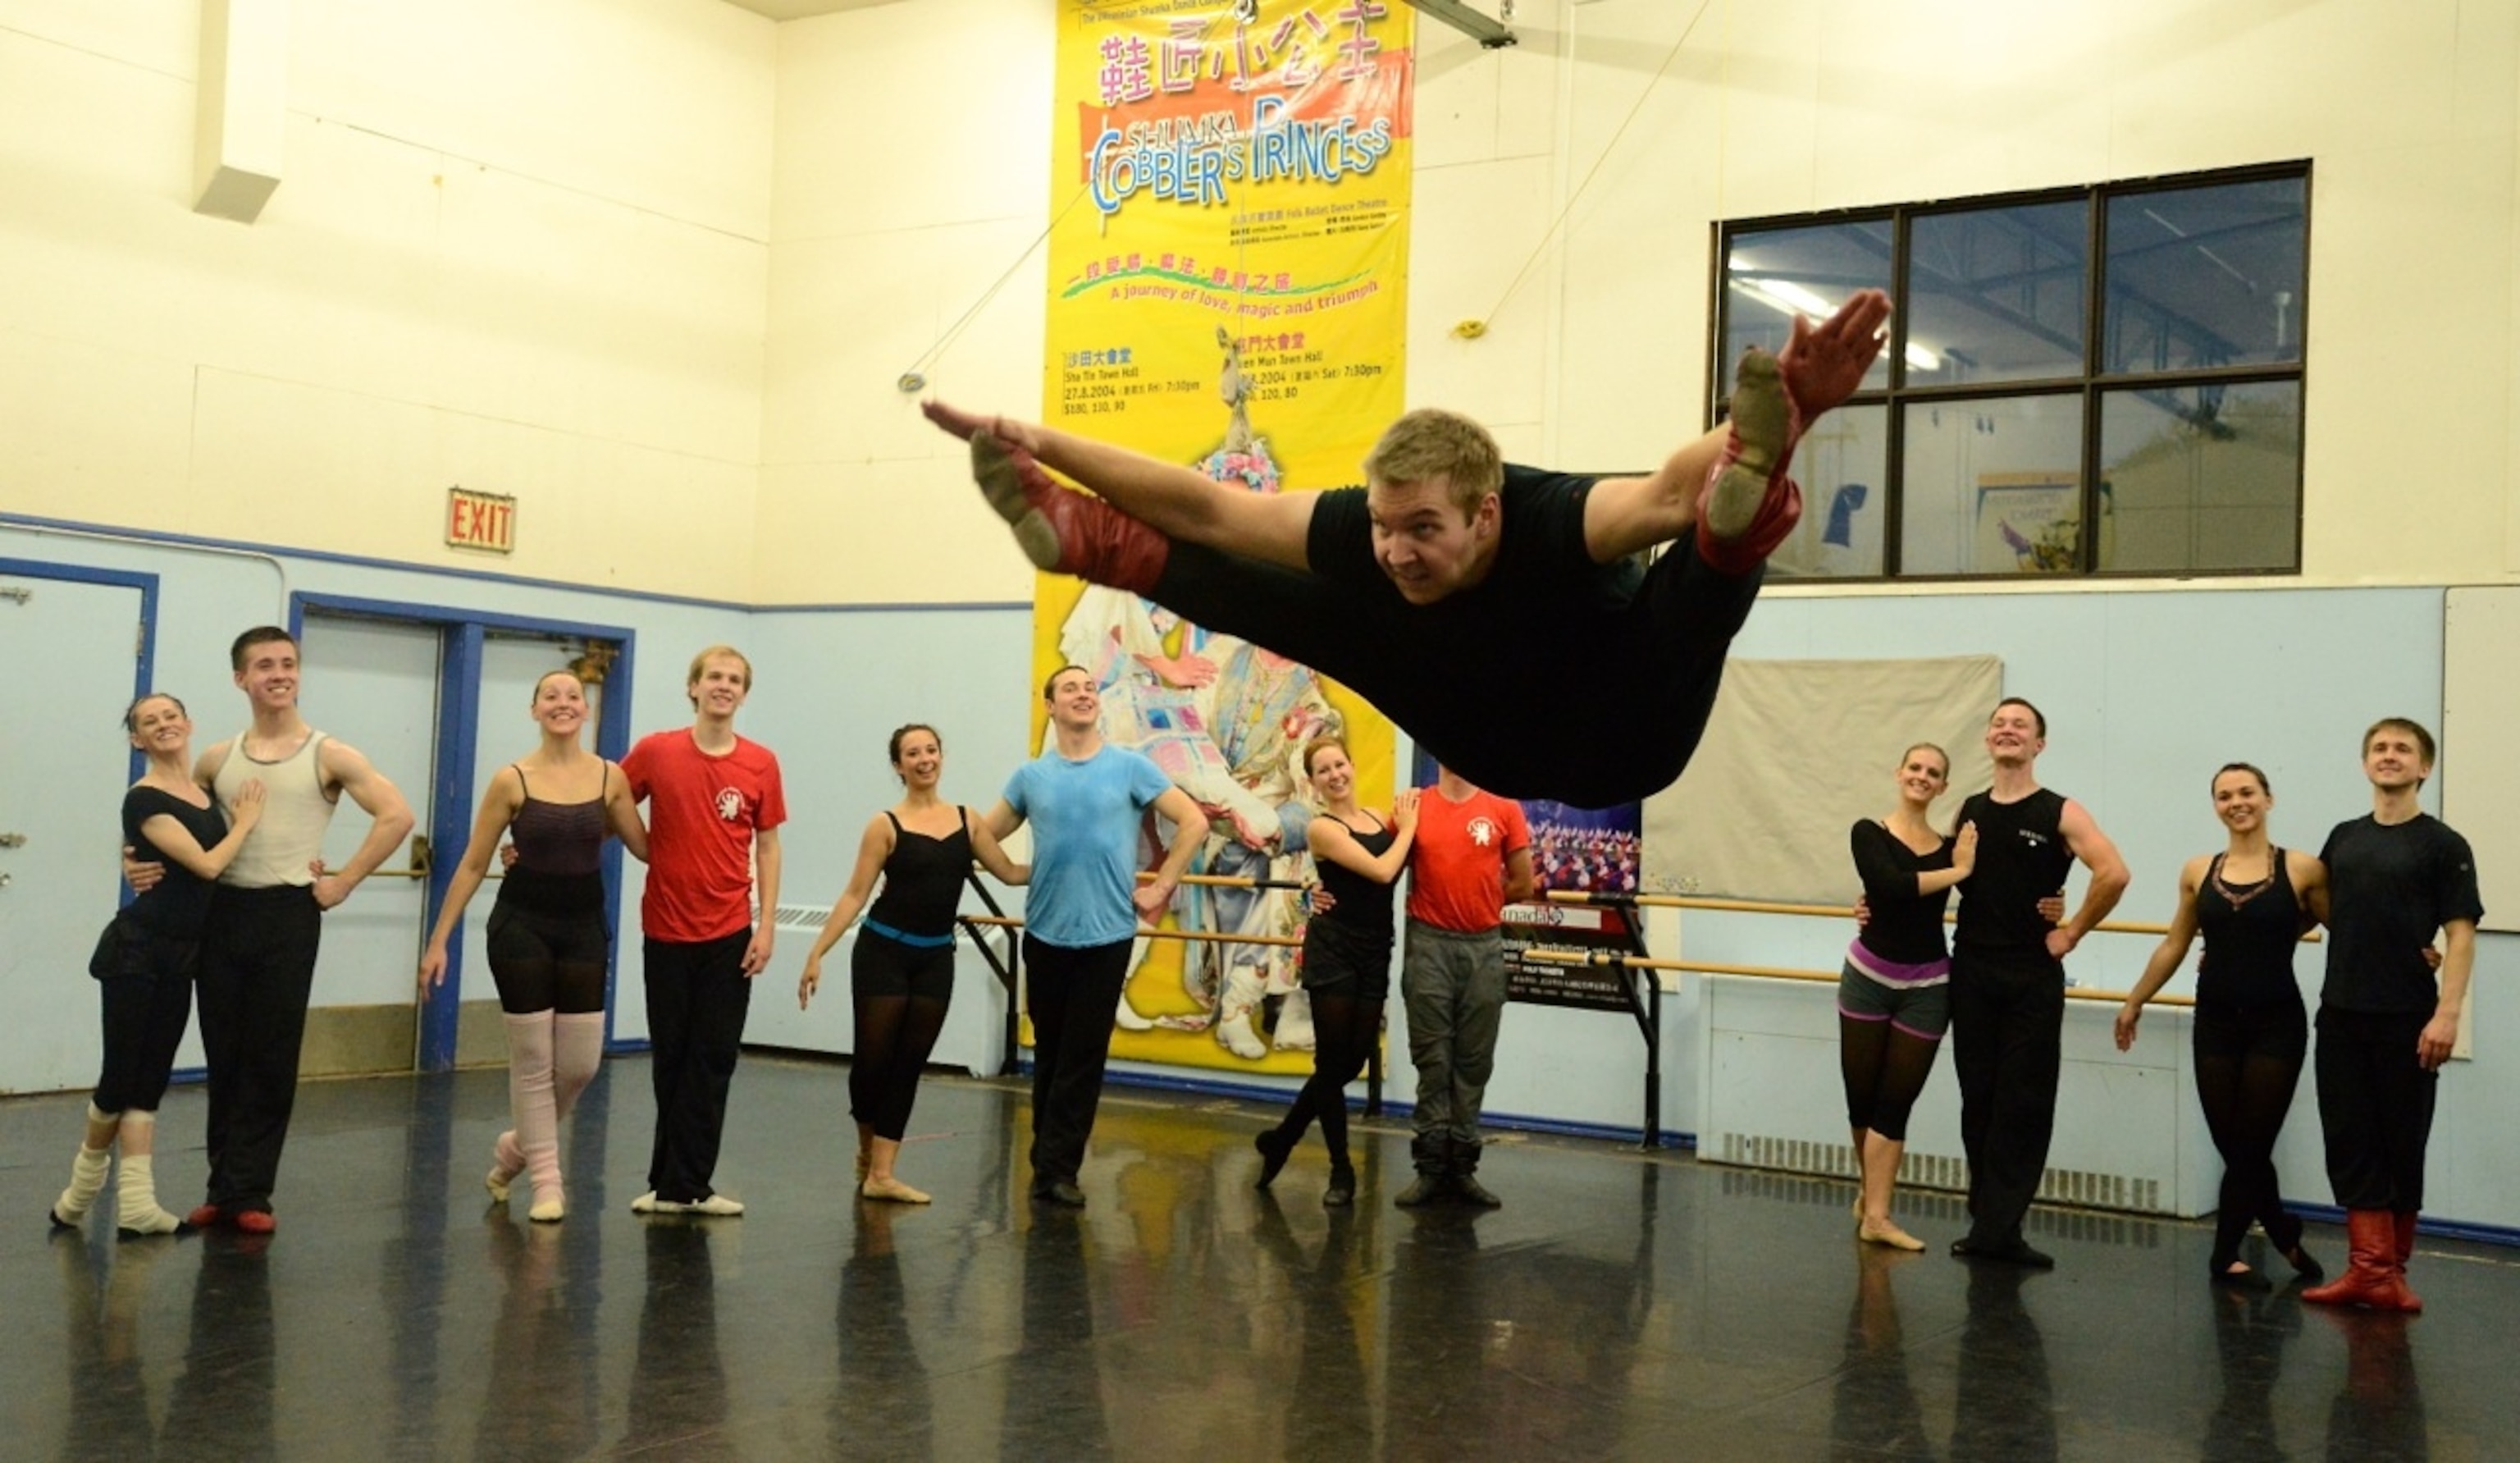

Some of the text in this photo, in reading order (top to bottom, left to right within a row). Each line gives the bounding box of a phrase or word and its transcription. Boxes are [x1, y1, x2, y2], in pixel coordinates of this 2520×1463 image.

[1100, 0, 1386, 105] 鞋匠小公主
[1126, 112, 1238, 150] SHUMKA
[1250, 96, 1392, 181] PRINCESS
[1111, 280, 1379, 320] A journey of love, magic and triumph
[1067, 347, 1132, 368] 沙田大會堂
[1258, 356, 1277, 368] Mun
[1280, 354, 1301, 365] Town
[1304, 350, 1323, 363] Hall
[1344, 363, 1382, 379] 7:30pm
[1284, 386, 1298, 399] 80
[452, 498, 511, 546] EXIT
